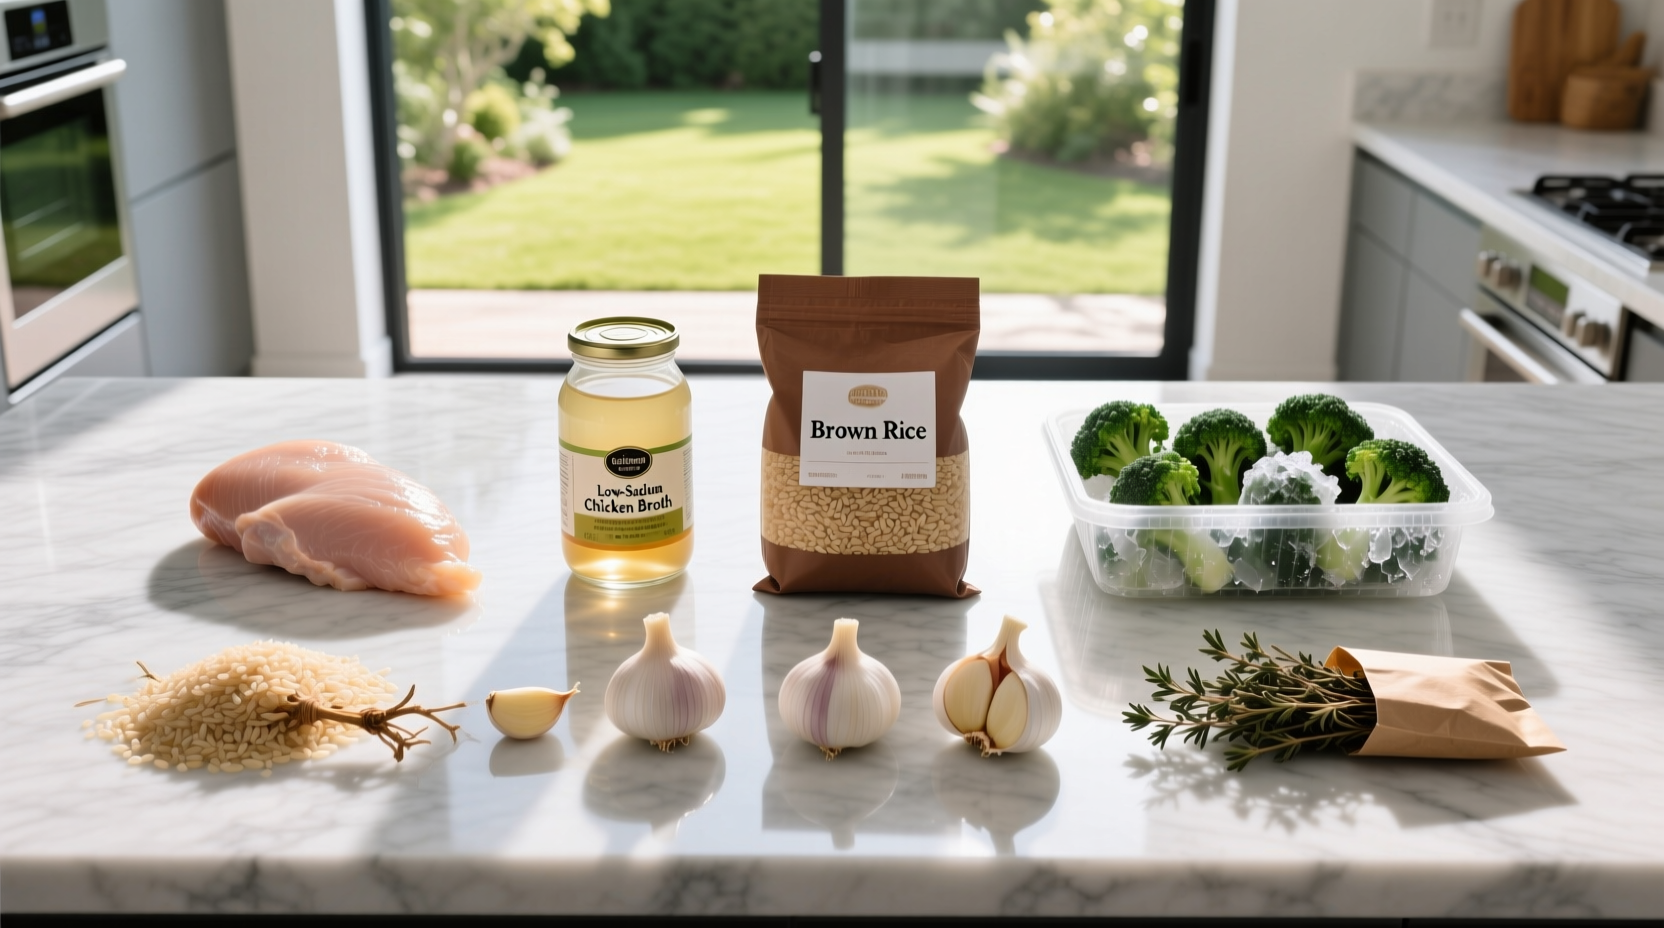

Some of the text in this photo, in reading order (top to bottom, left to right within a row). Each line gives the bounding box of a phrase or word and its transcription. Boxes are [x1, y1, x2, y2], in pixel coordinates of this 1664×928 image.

[810, 420, 927, 440] Brown Rice
[584, 494, 672, 513] Chicken Broth
